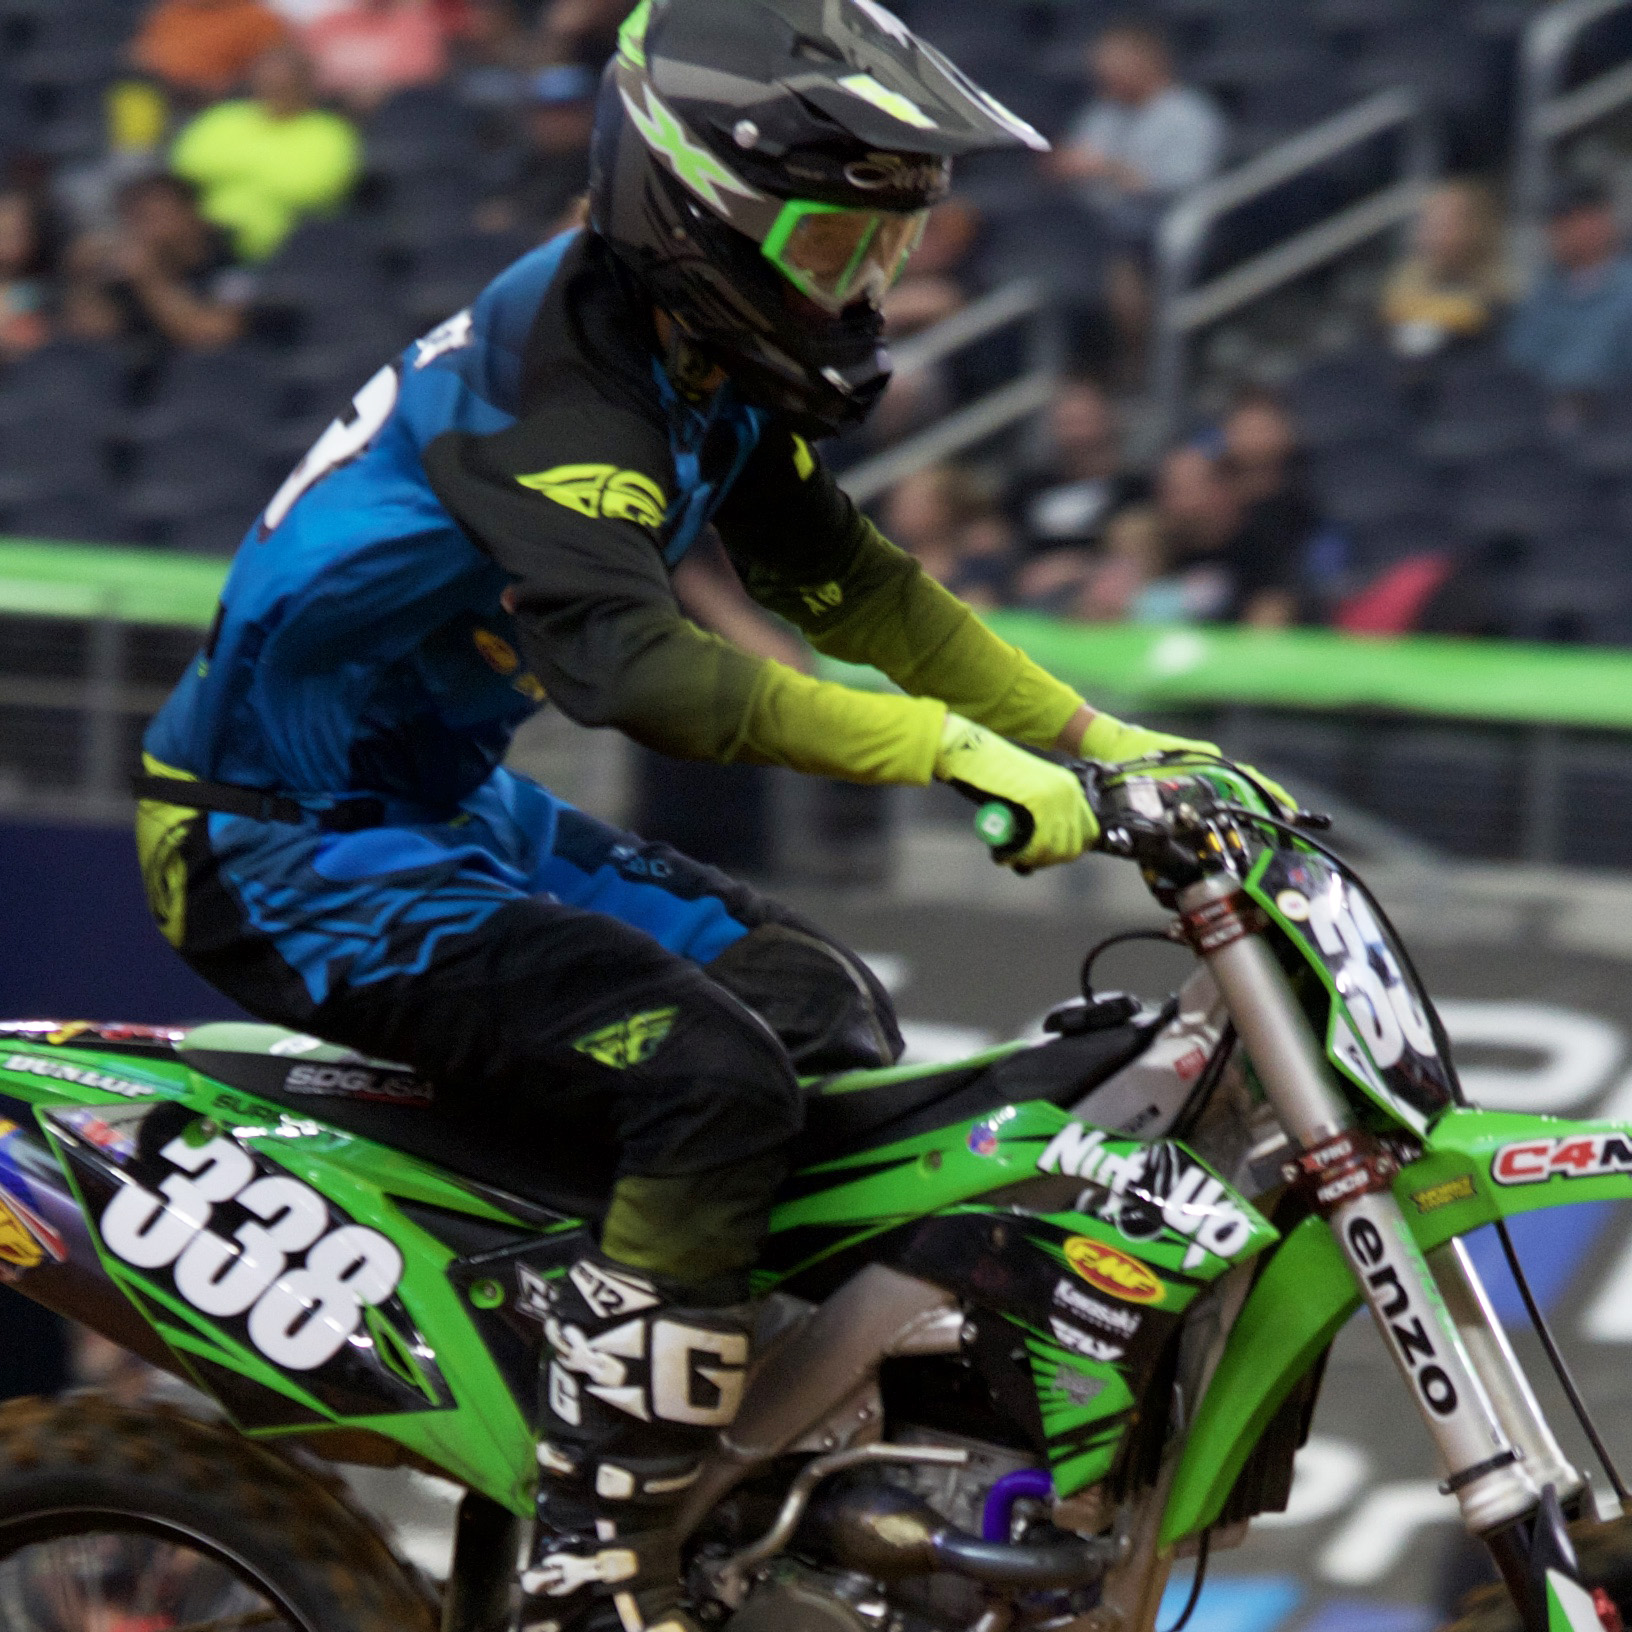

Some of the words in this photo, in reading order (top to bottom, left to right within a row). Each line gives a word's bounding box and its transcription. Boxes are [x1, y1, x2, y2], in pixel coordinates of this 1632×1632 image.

[99, 1135, 404, 1371] 338
[1066, 1240, 1158, 1300] FMF
[1347, 1216, 1458, 1416] enzo
